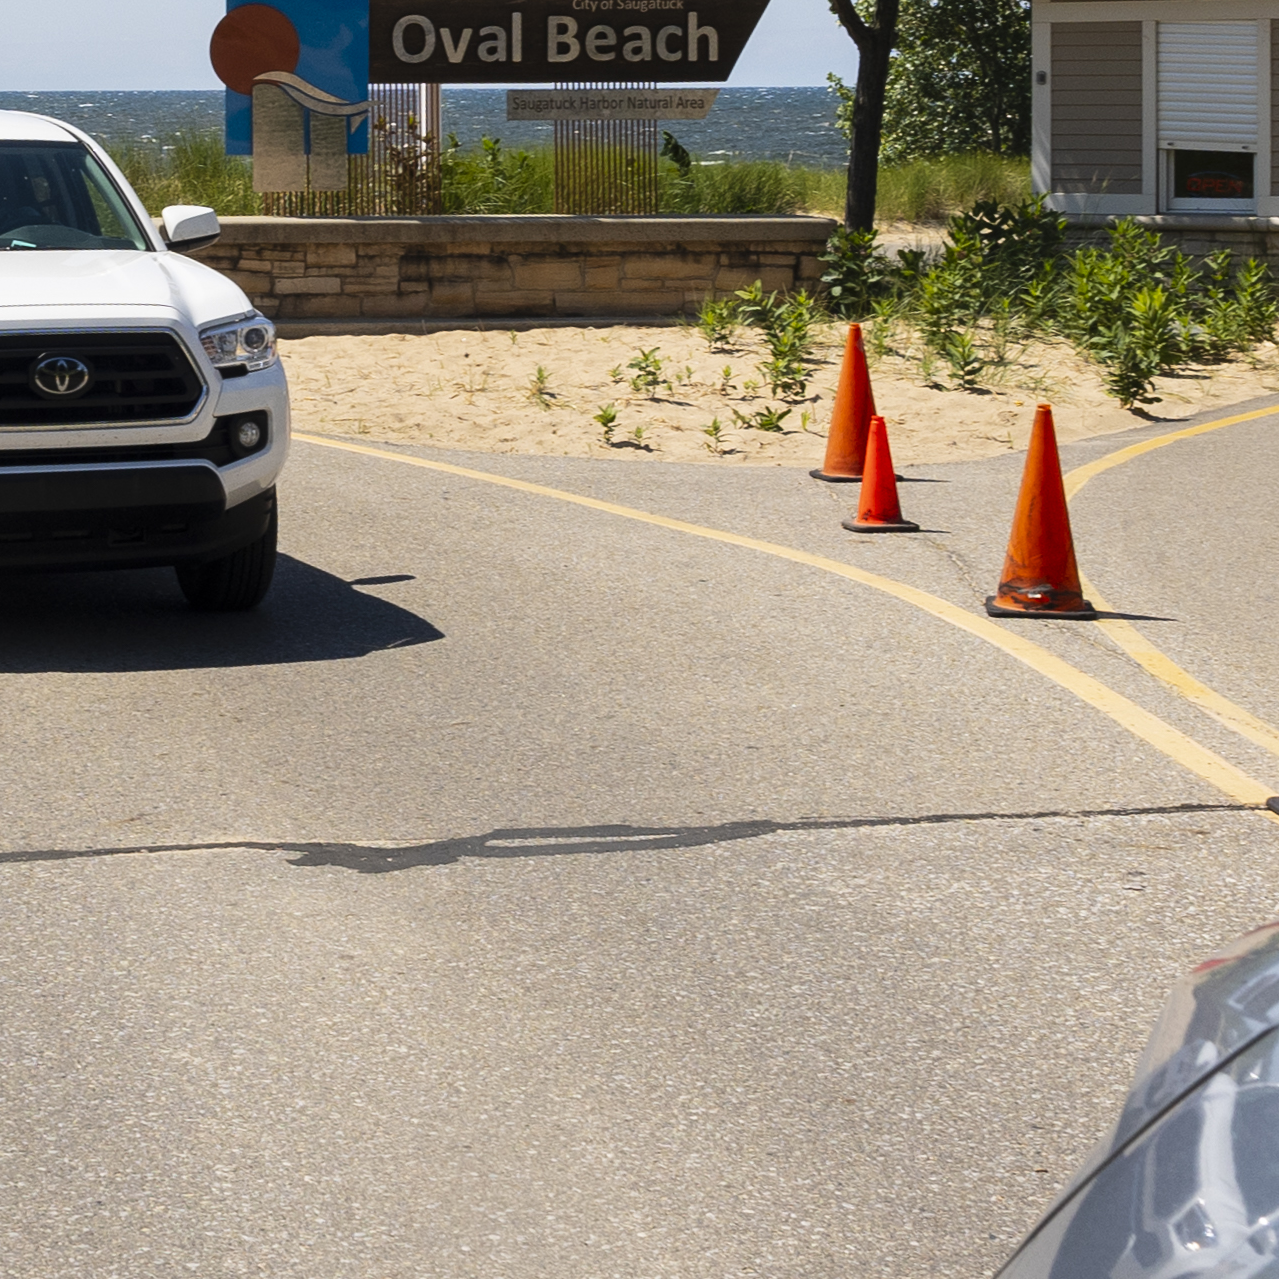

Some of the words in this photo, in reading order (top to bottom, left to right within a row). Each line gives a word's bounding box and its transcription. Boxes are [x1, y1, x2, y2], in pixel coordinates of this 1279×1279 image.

[391, 11, 522, 63] Oval
[546, 11, 719, 63] Beach
[512, 96, 576, 113] Saugatuck
[580, 96, 623, 110] Harbor
[627, 96, 673, 110] Natural
[675, 96, 705, 110] Area
[1186, 178, 1244, 194] OPEN
